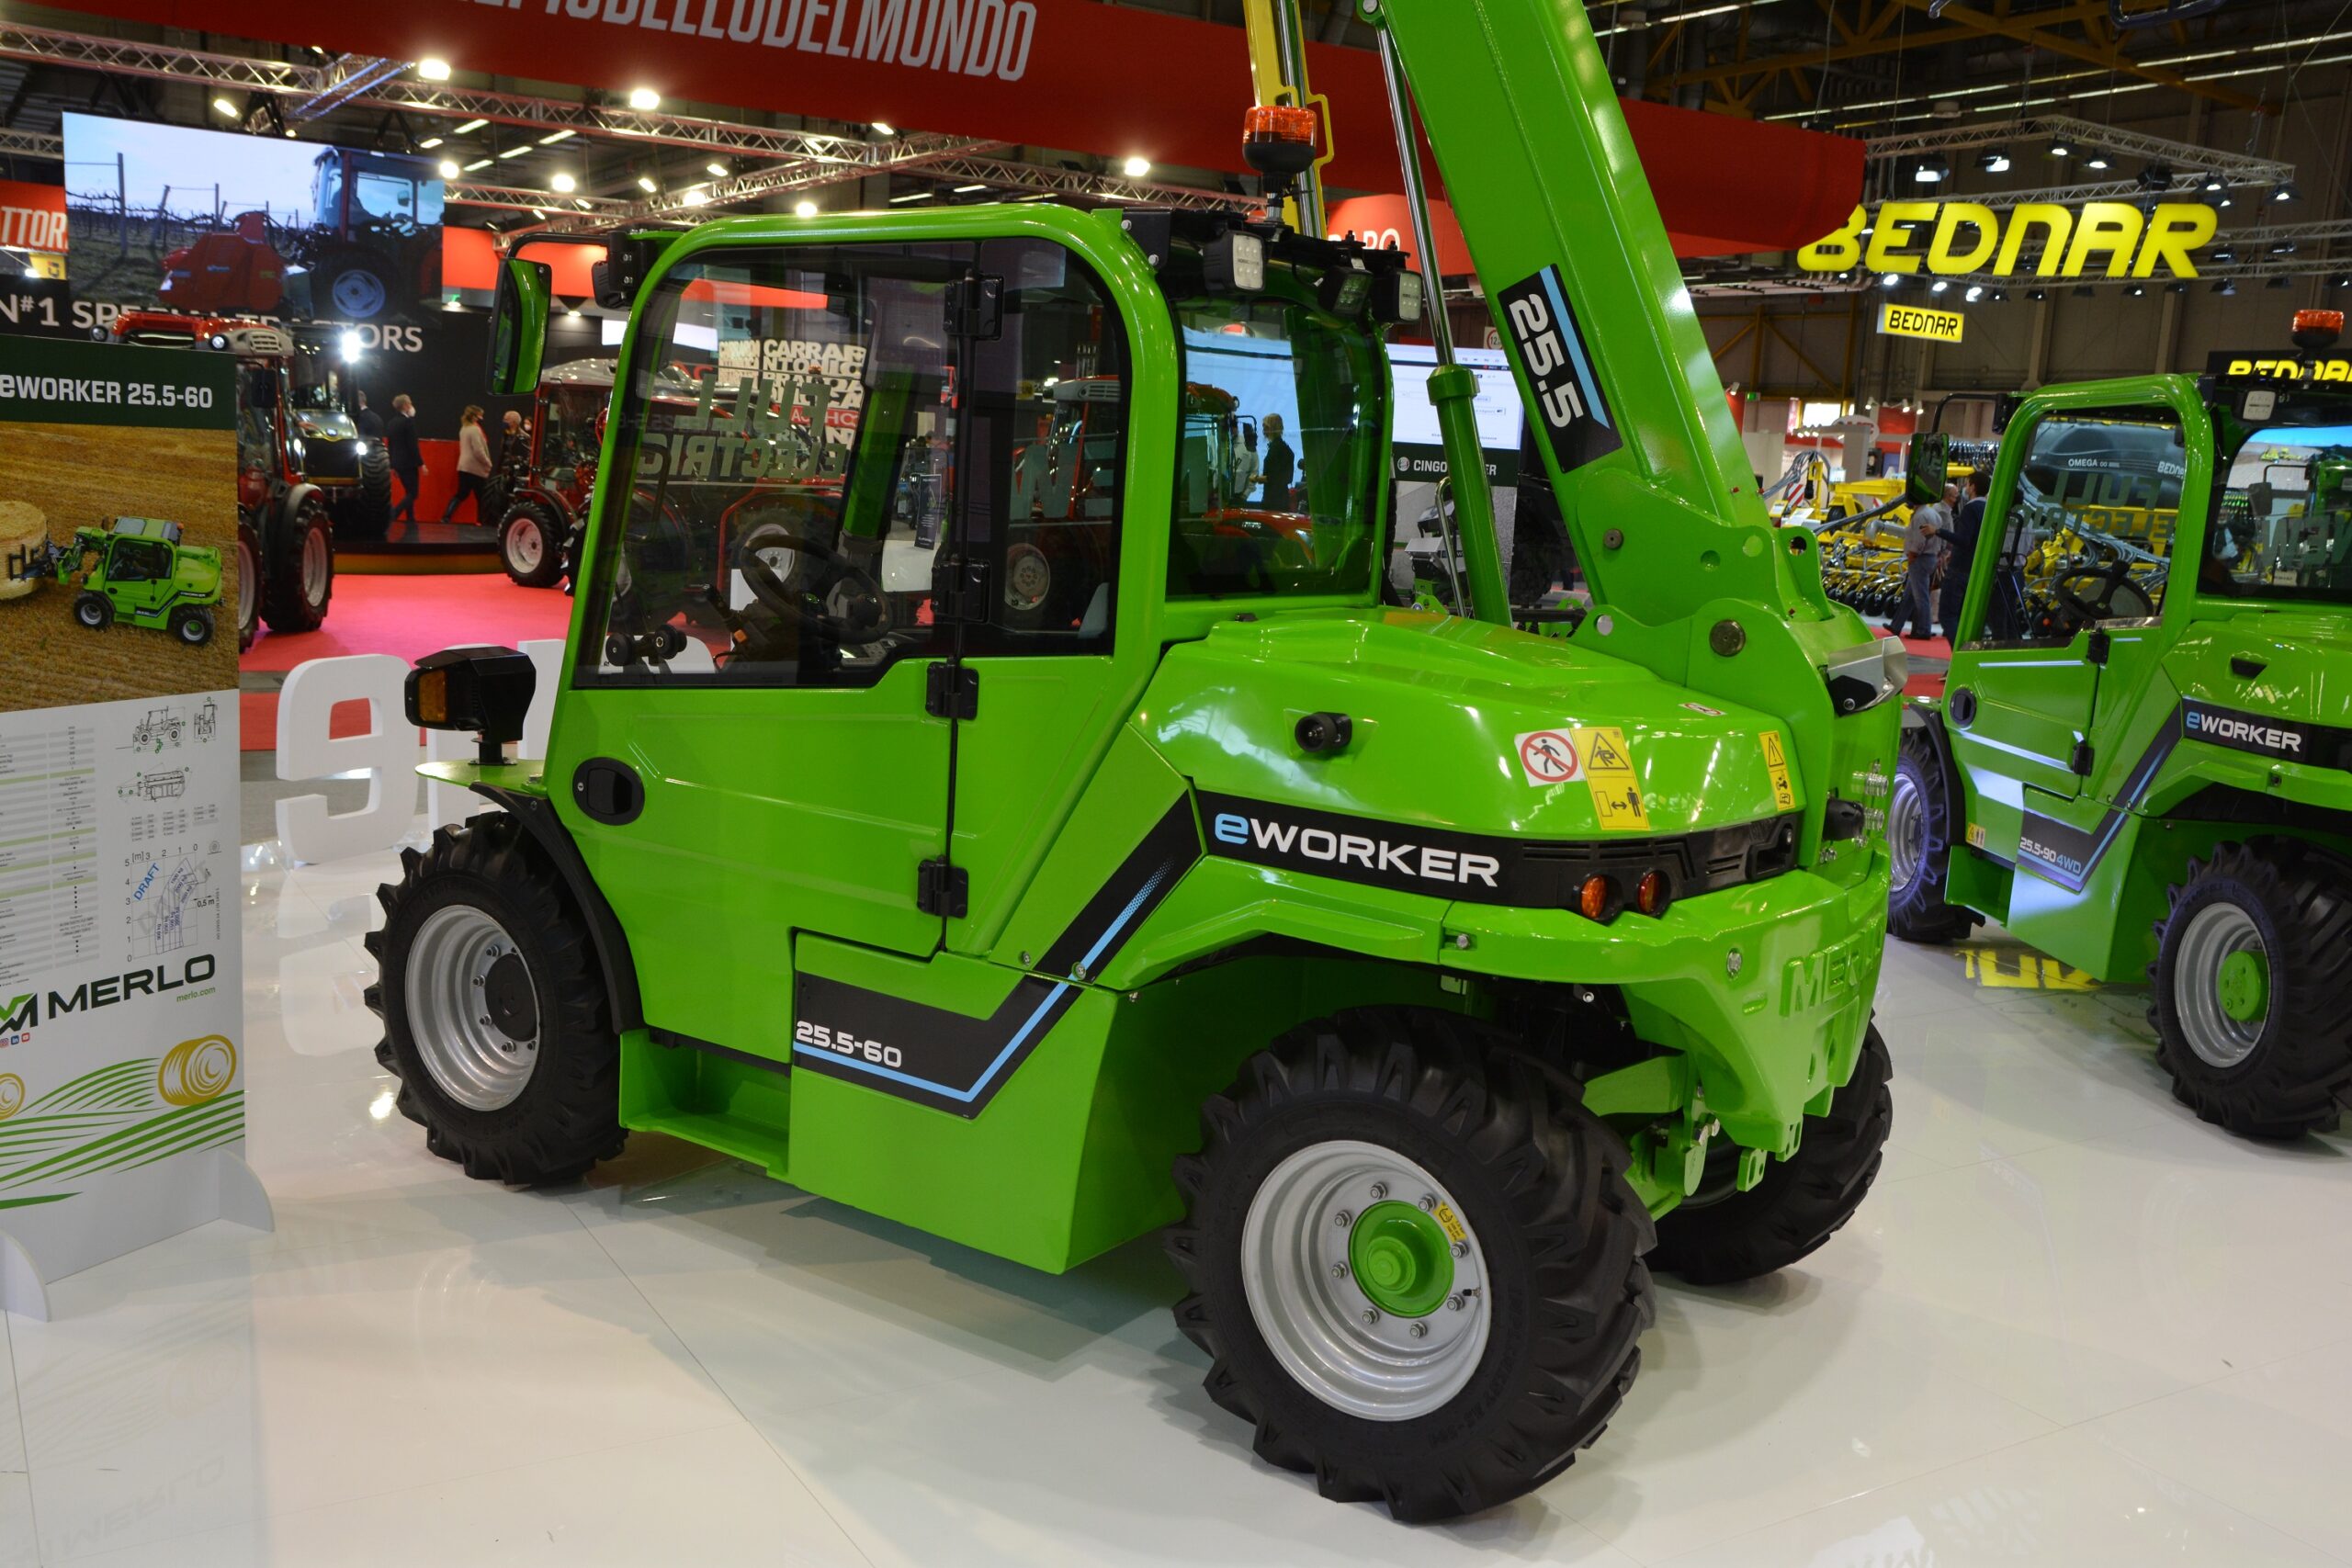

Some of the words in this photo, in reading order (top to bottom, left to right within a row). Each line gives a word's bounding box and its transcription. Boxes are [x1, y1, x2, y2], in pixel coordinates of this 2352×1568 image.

[1797, 201, 2218, 277] BEDNAR
[1889, 310, 1958, 336] BEDNAR
[1509, 293, 1584, 428] 25.5
[0, 374, 121, 404] eWORKER
[127, 382, 213, 409] 25.5-60
[1413, 459, 1448, 472] CINGO
[2068, 458, 2098, 467] OMEGA
[2157, 461, 2185, 475] BEDNA
[2186, 711, 2301, 752] eWORKER
[124, 858, 130, 867] 5
[145, 852, 151, 860] 3
[162, 849, 167, 857] 2
[193, 843, 198, 852] 0
[1214, 812, 1500, 887] eWORKER
[2019, 837, 2056, 863] 25.5-90
[2056, 853, 2082, 874] 4WD
[133, 863, 160, 901] DRAFT
[126, 897, 131, 906] 3
[126, 916, 131, 924] 2
[127, 954, 132, 963] 0
[48, 953, 216, 1020] MERLO
[176, 986, 216, 1003] merlo.com
[796, 1021, 902, 1068] 25.5-60
